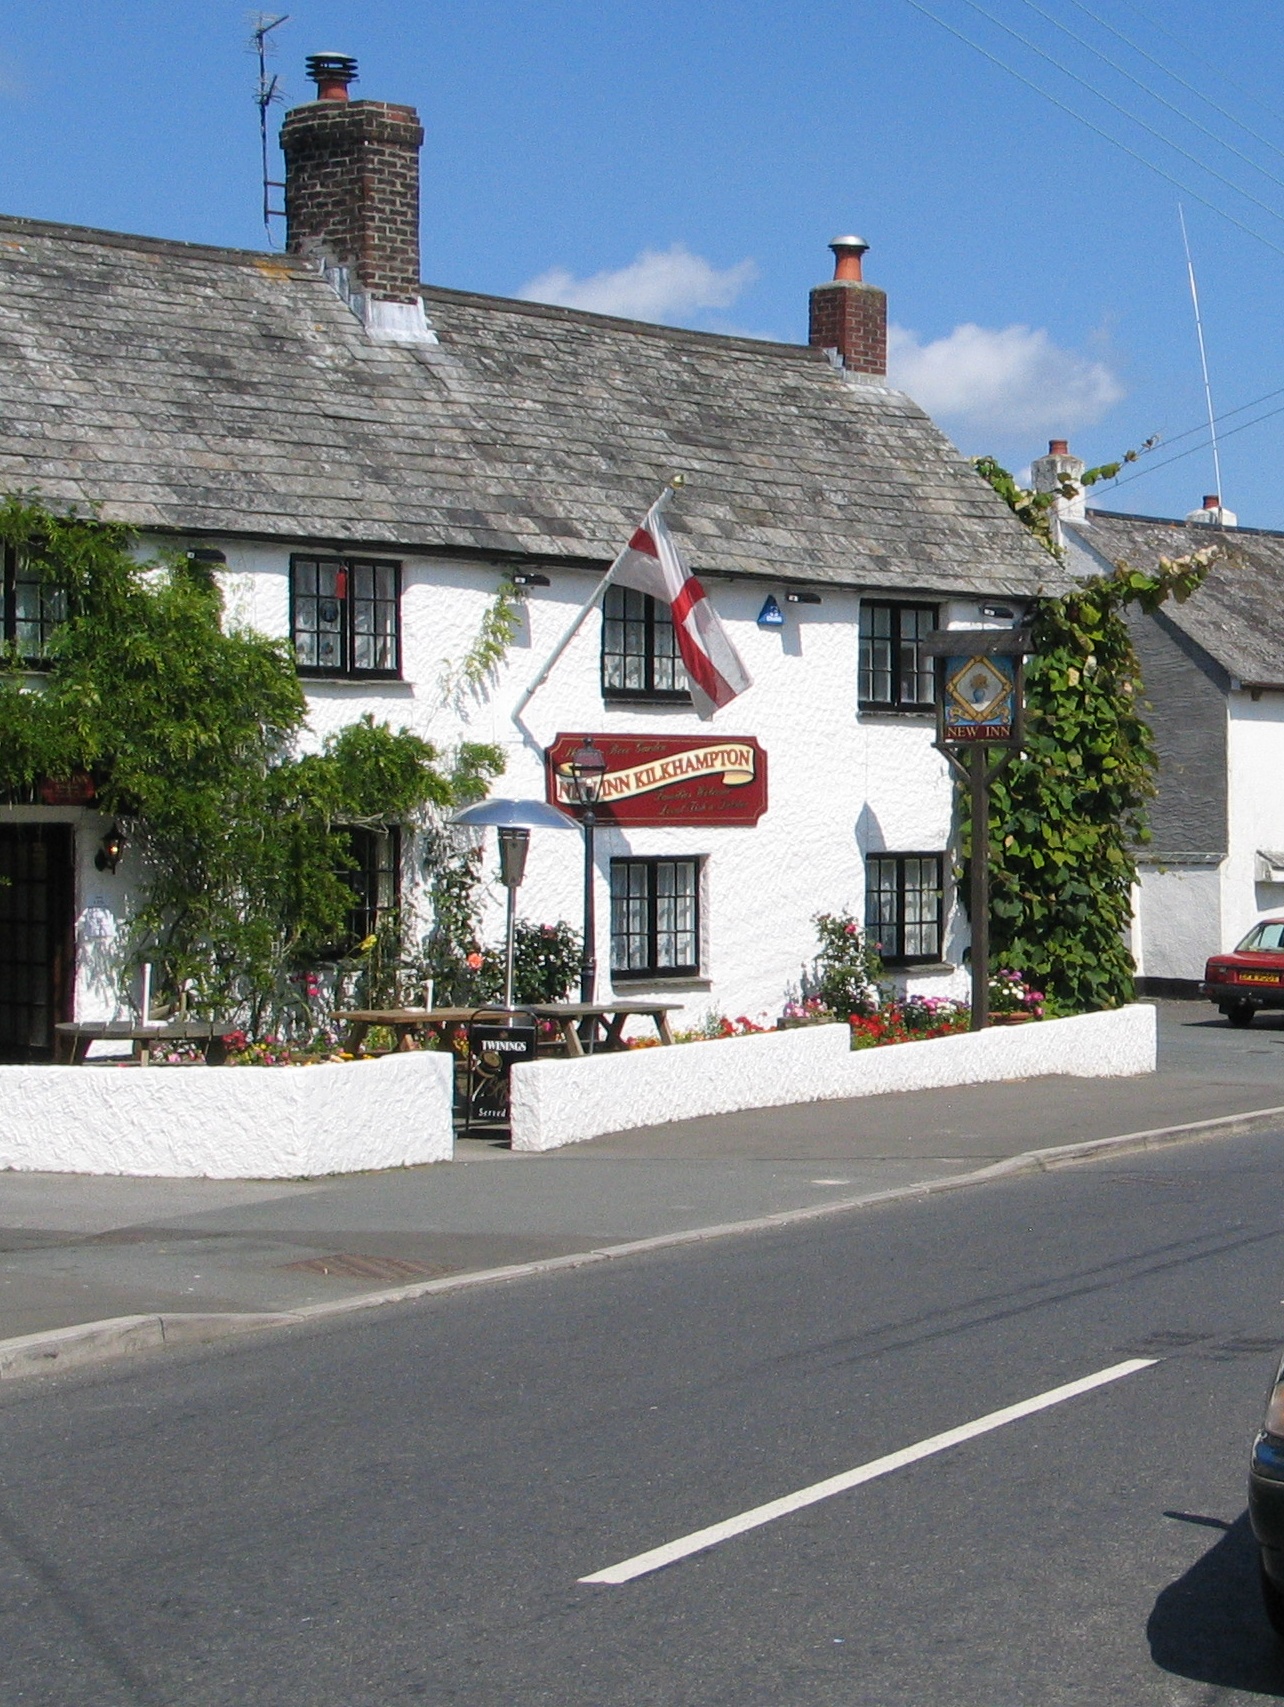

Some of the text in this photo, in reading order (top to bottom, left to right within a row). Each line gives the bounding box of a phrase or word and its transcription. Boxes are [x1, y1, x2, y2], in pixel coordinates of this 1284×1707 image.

[947, 726, 1011, 738] NEW INN
[601, 773, 631, 797] INN
[633, 748, 751, 791] KILKHAMPTON
[481, 1039, 527, 1052] TWININGS
[478, 1107, 507, 1118] Served
